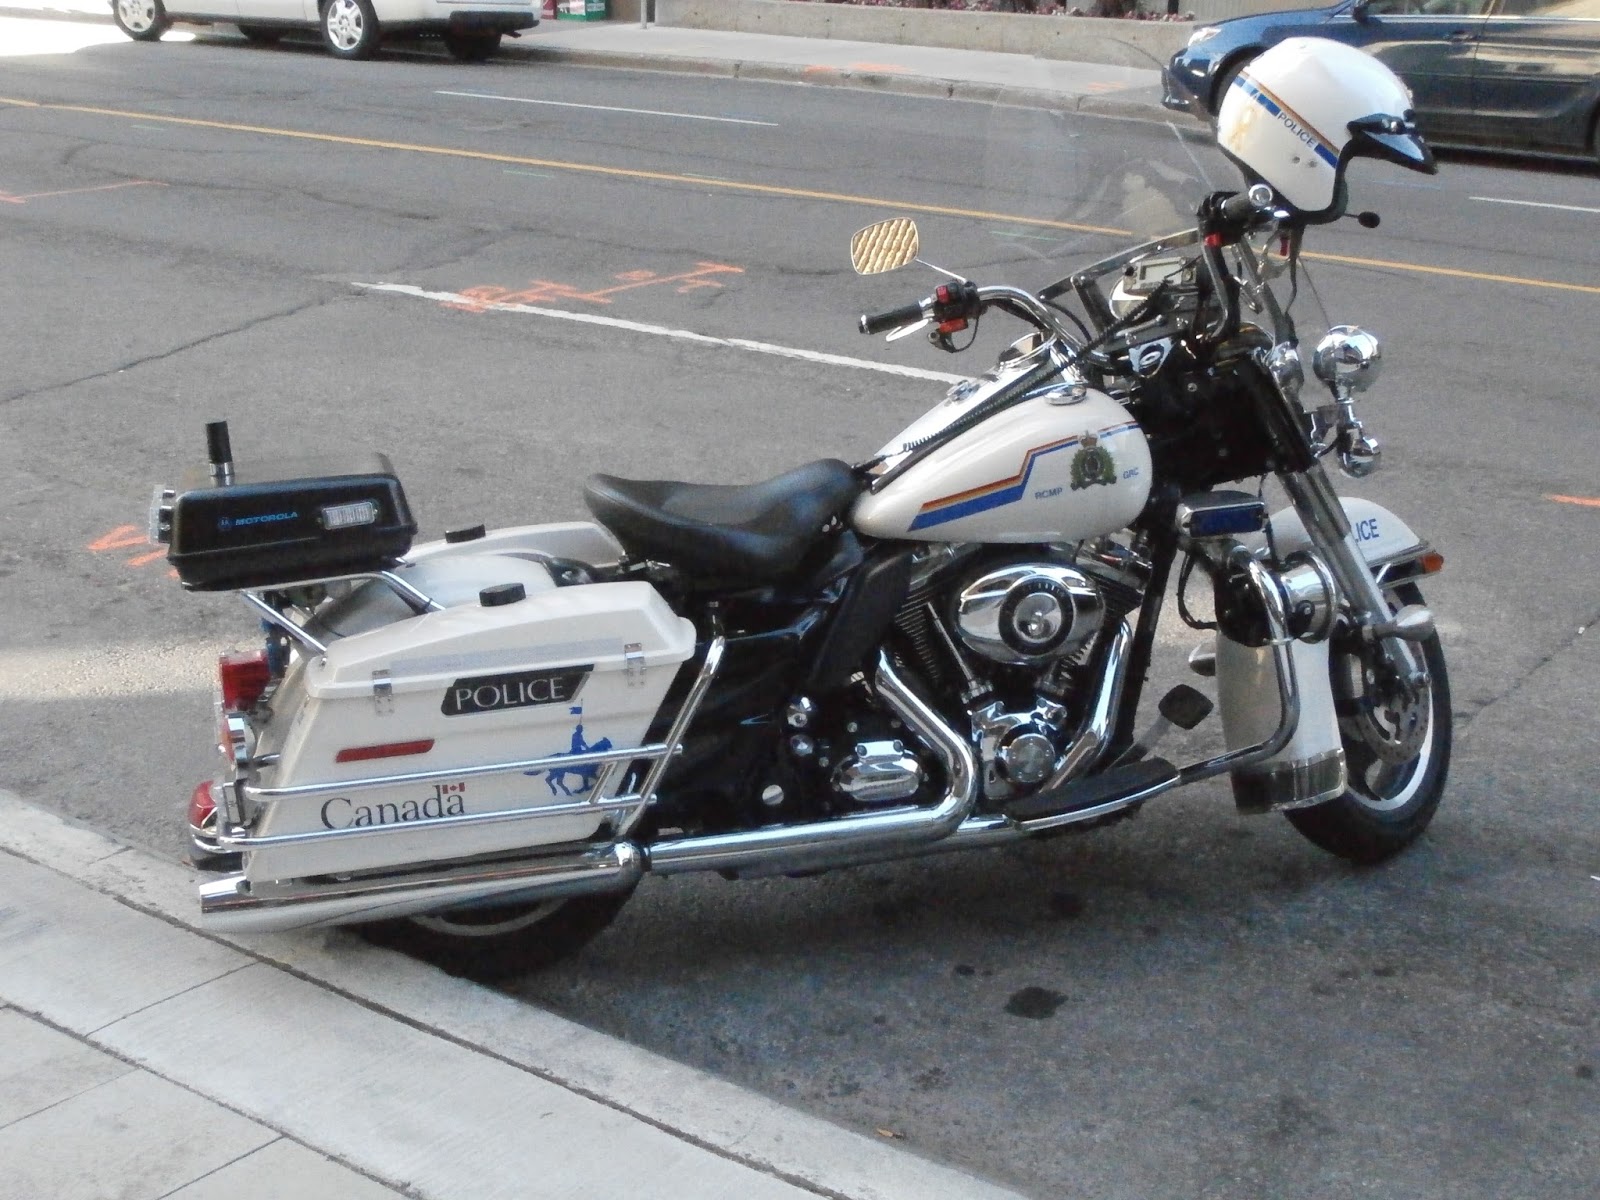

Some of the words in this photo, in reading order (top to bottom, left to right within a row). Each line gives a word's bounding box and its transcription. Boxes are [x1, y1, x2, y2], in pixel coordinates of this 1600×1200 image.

[1277, 112, 1319, 149] POLICE
[1122, 467, 1139, 480] GRC
[1034, 487, 1063, 500] RCMP
[235, 511, 298, 526] MOTOROLA
[1354, 518, 1380, 543] ICE
[454, 677, 566, 711] POLICE
[319, 783, 465, 831] Canada
